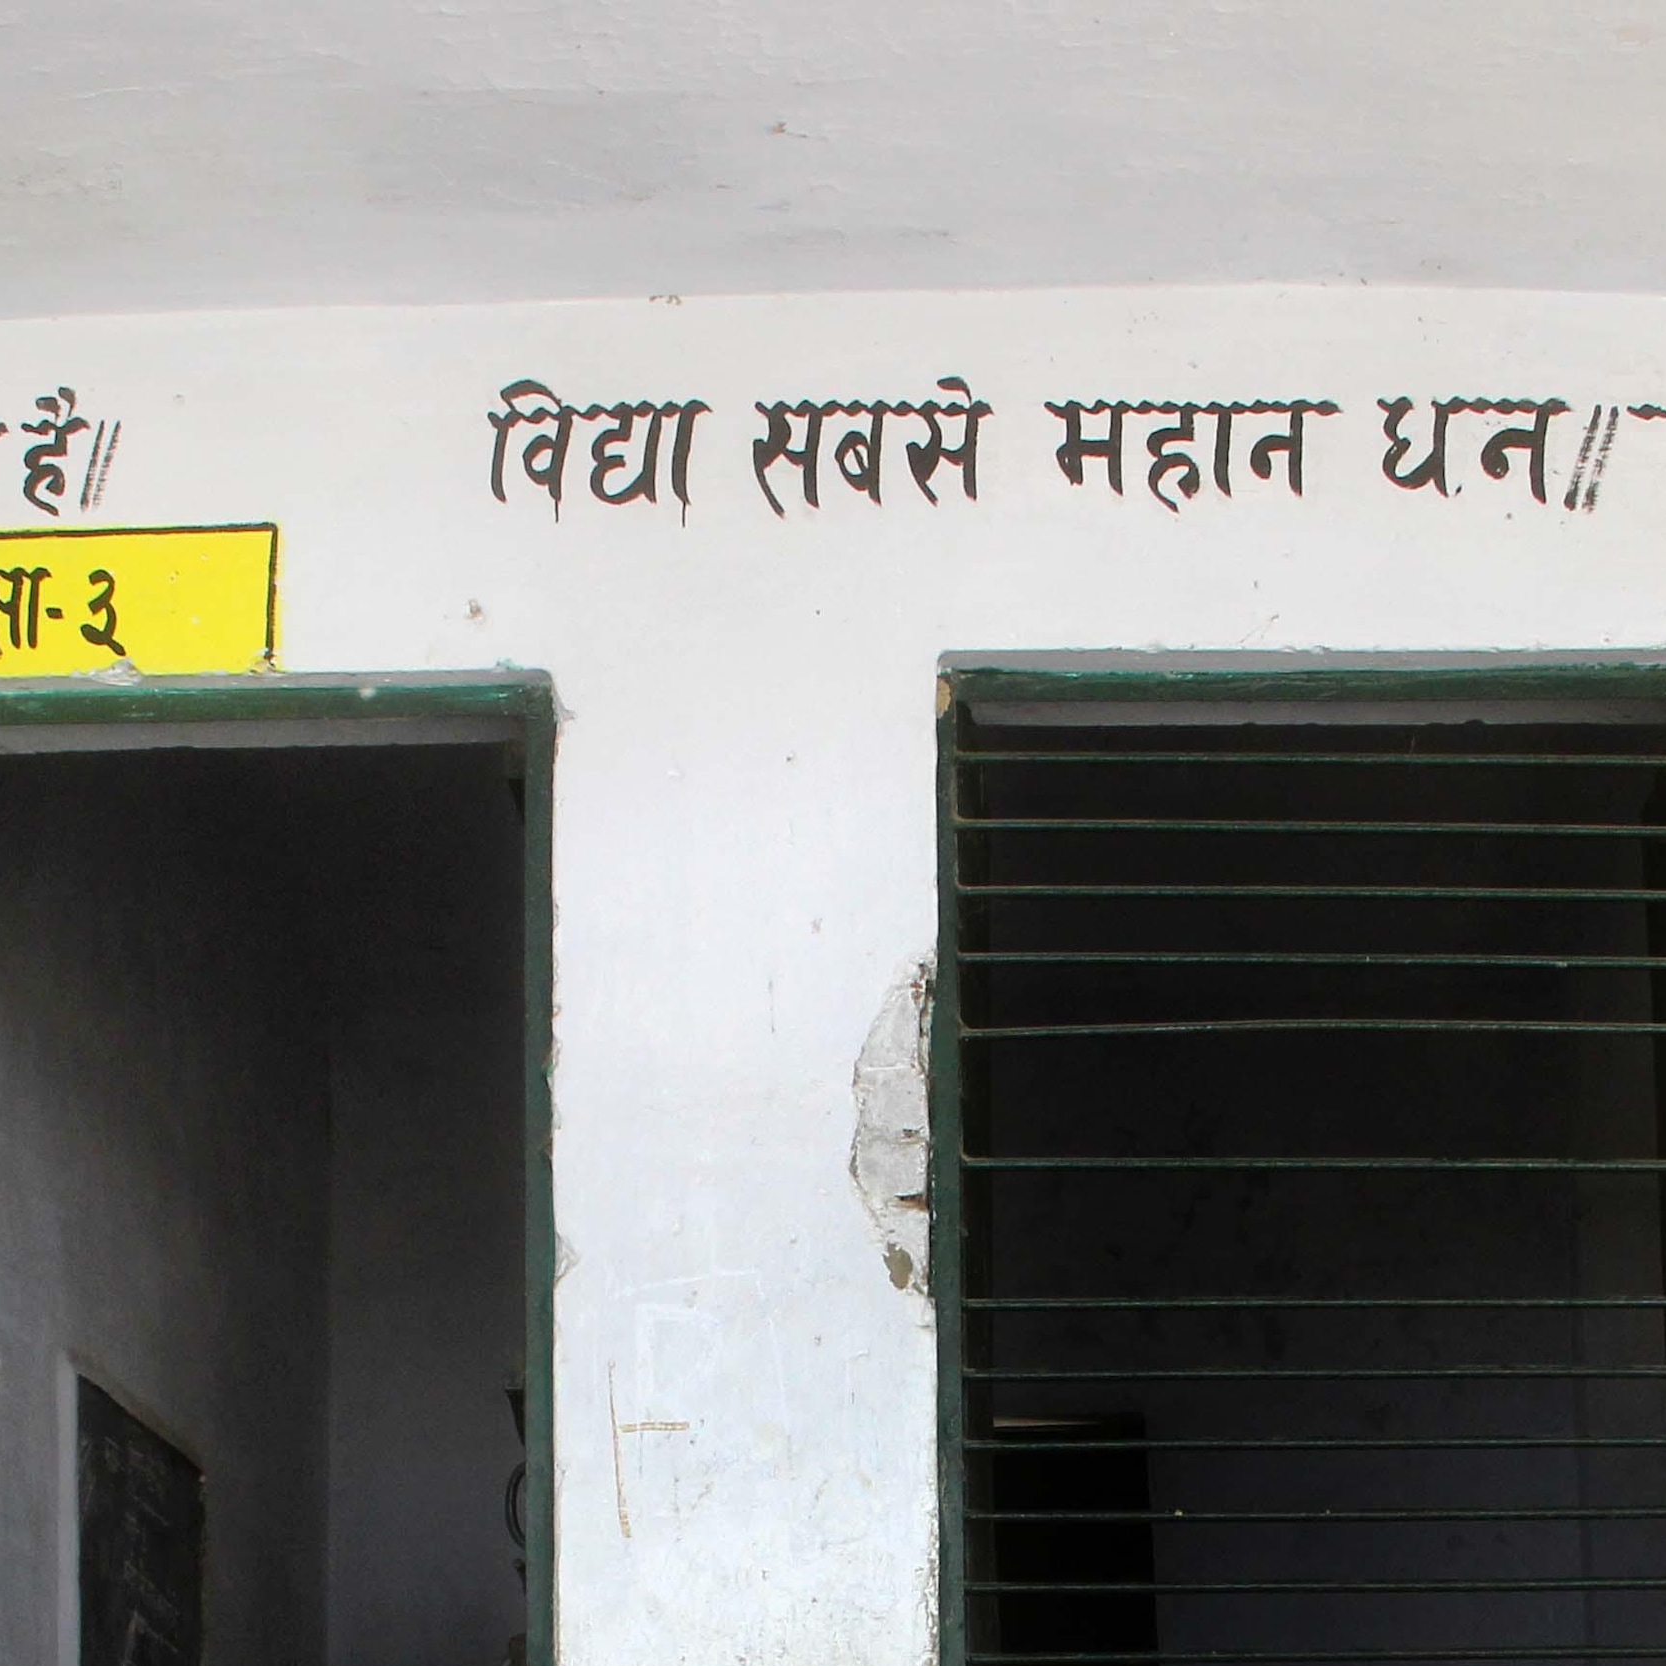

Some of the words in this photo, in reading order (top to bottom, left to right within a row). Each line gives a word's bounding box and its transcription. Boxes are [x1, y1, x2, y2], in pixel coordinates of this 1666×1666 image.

[487, 378, 713, 527] विद्या
[752, 376, 994, 519] सबसे
[1044, 399, 1343, 515] महान
